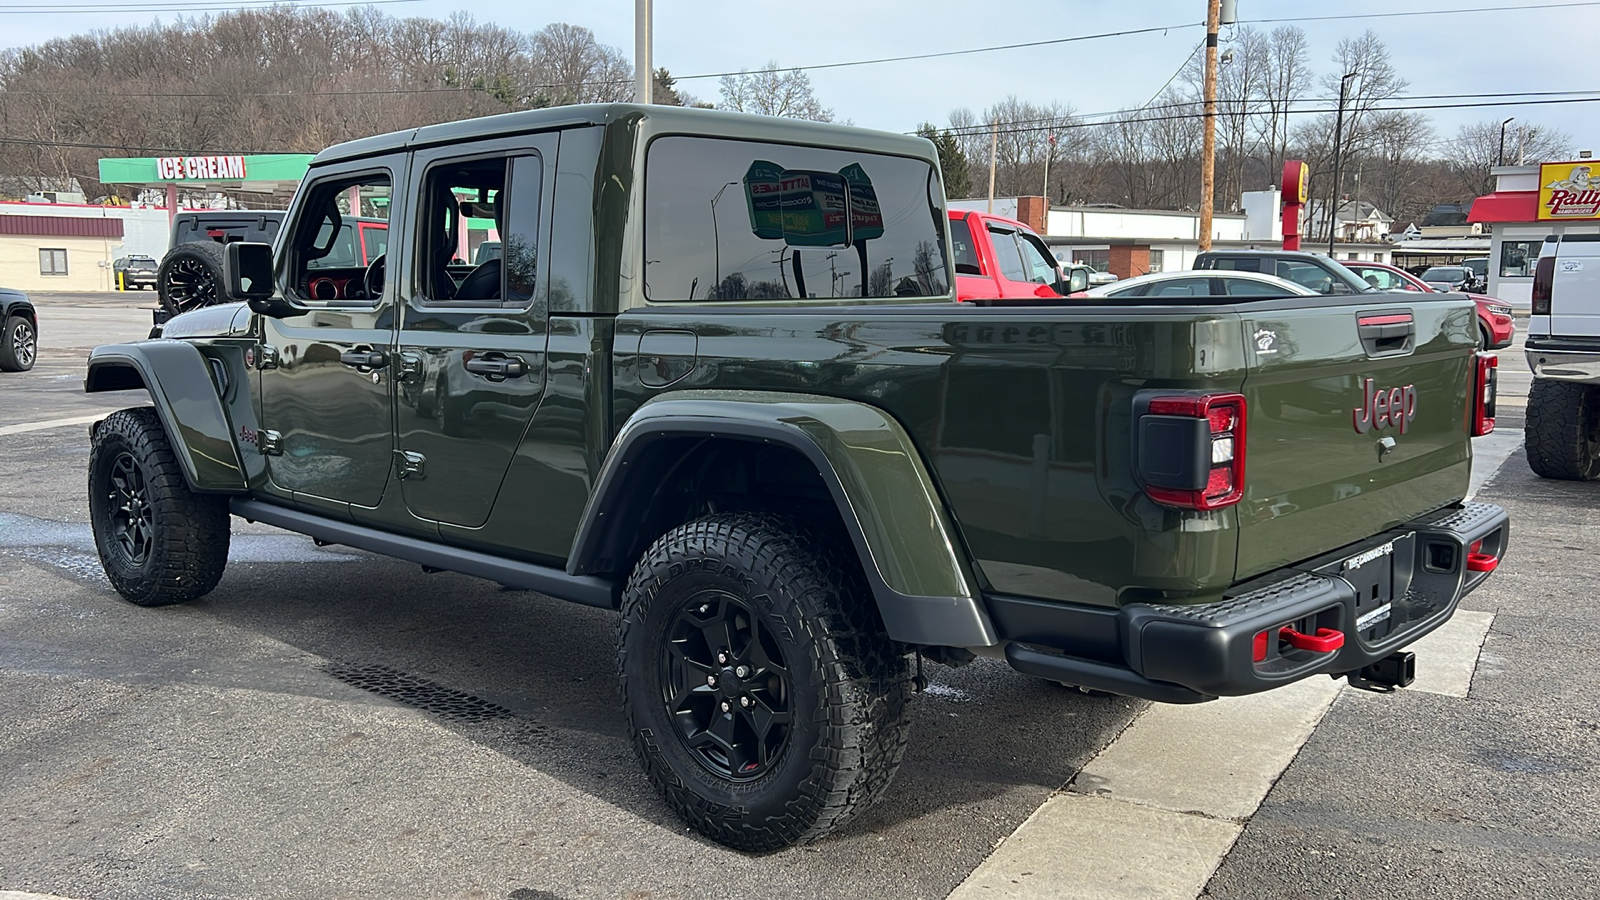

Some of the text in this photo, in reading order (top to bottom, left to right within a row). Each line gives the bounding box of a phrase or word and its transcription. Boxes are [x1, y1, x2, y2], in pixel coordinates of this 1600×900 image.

[156, 156, 246, 180] ICE CREAM
[1352, 377, 1418, 435] Jeep
